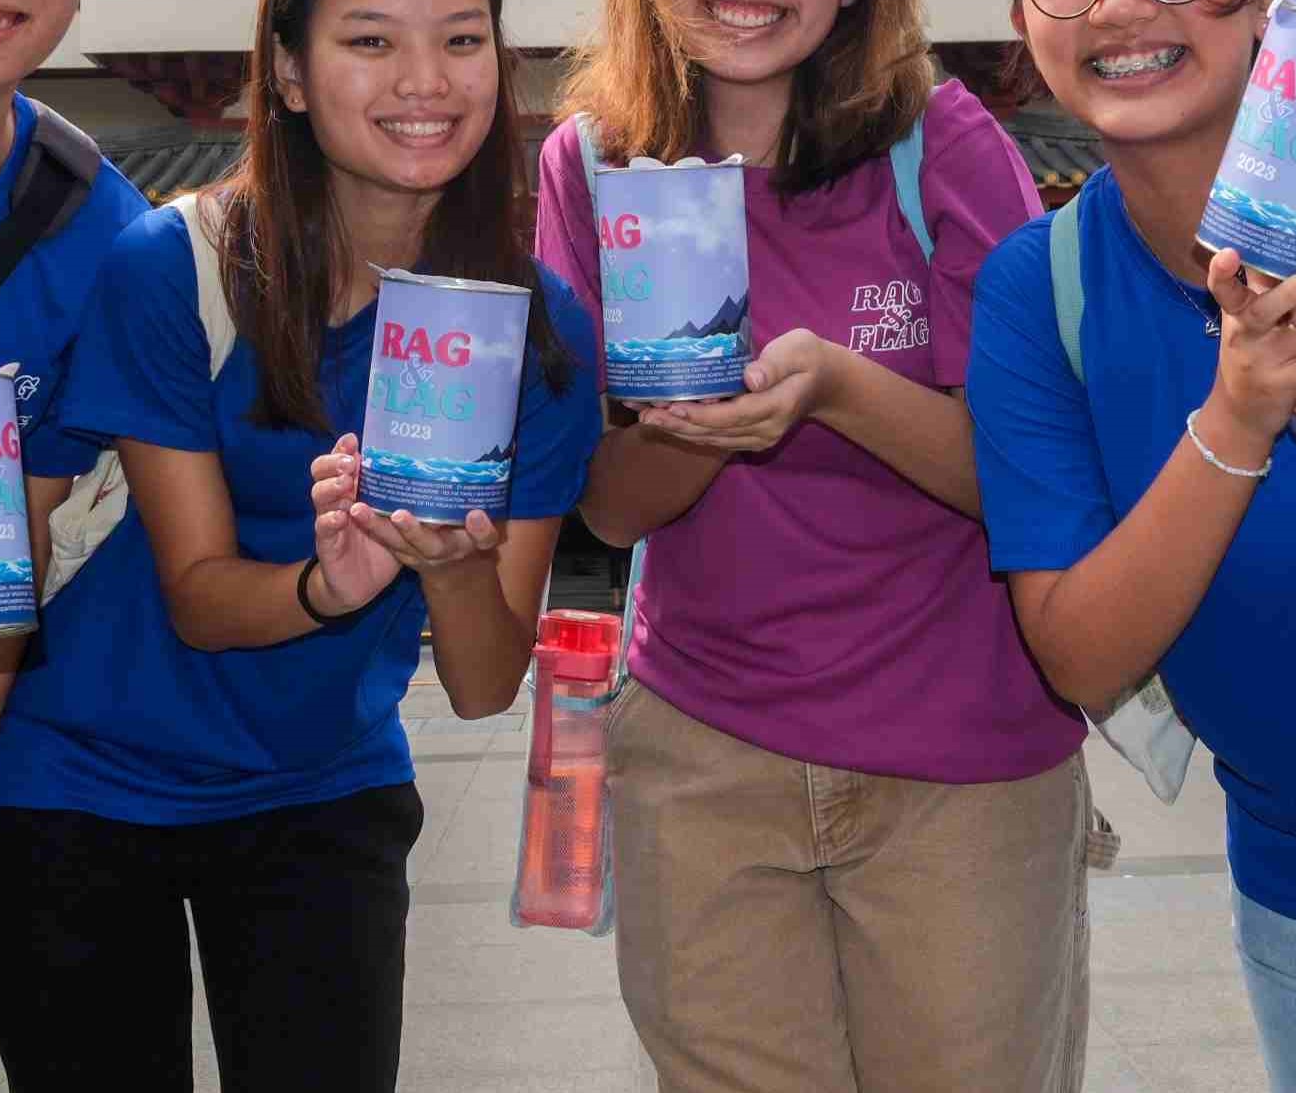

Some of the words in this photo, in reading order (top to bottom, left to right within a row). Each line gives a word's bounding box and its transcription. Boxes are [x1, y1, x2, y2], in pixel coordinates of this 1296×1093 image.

[1257, 91, 1295, 122] &
[1237, 152, 1277, 182] 2023
[599, 213, 641, 249] AG
[849, 317, 930, 352] FLAG
[879, 305, 912, 331] &
[382, 322, 473, 367] RAG
[400, 354, 433, 389] &
[390, 420, 432, 440] 2023
